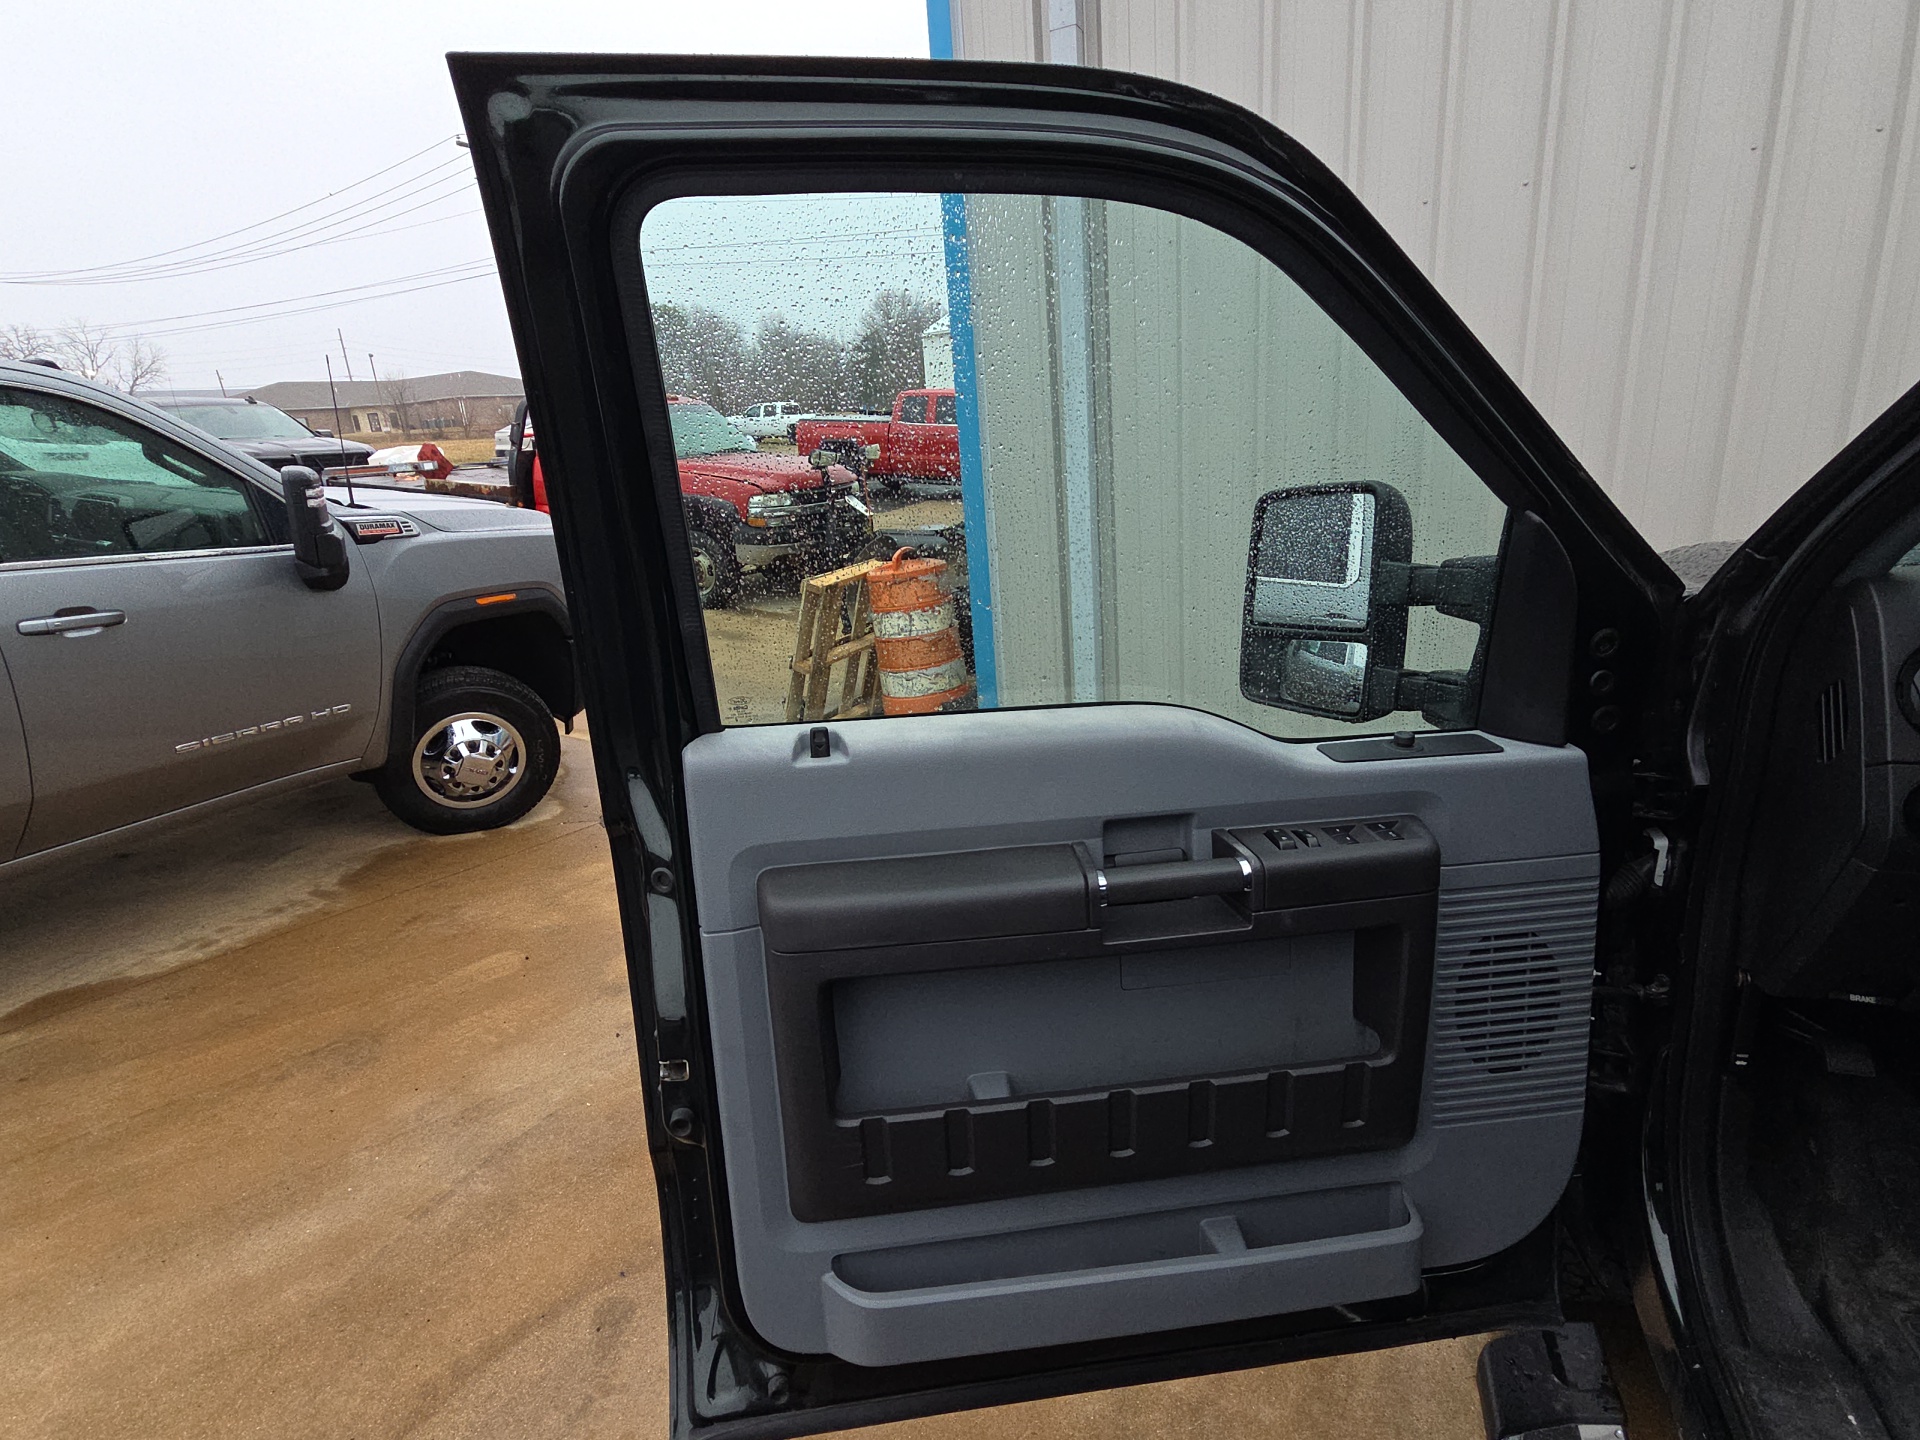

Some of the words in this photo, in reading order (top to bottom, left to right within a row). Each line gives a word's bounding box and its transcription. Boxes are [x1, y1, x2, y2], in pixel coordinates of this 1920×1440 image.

[358, 522, 395, 530] DURAMAX
[175, 715, 304, 754] SIERRA
[310, 703, 351, 721] HD
[1849, 993, 1876, 1004] BRAKE
